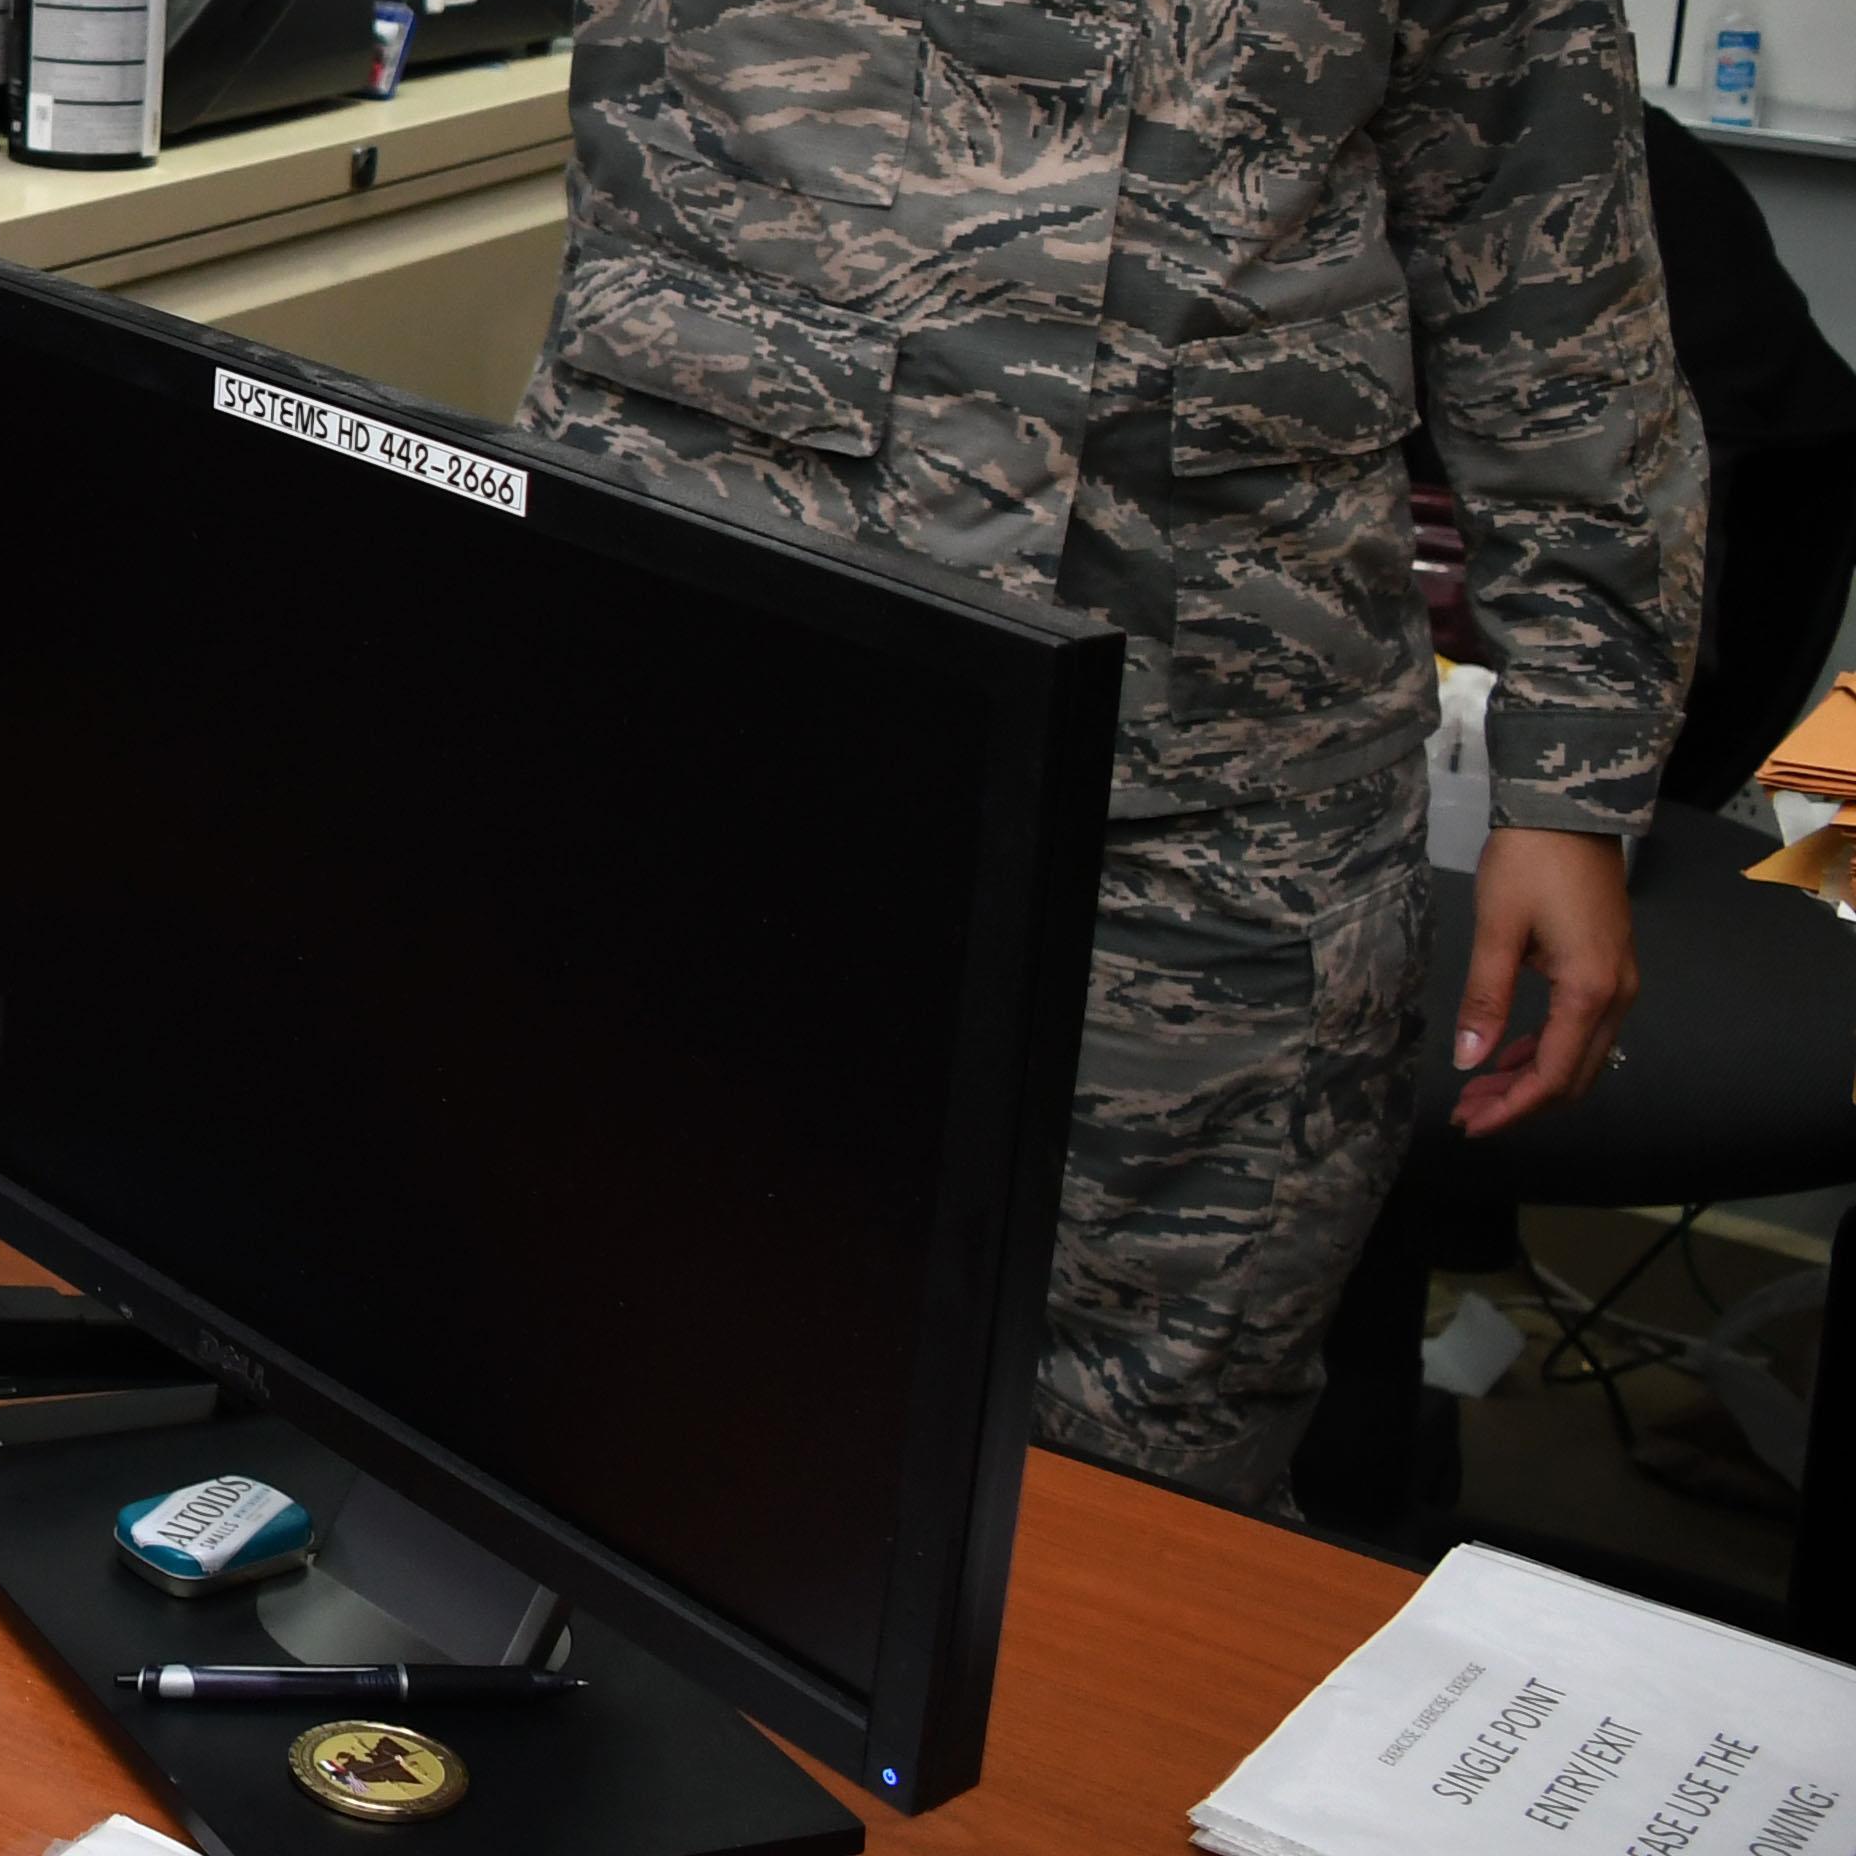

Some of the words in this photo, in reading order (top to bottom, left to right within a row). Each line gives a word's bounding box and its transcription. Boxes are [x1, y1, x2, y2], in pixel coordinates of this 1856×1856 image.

[224, 377, 328, 440] SYSTEMS
[339, 417, 370, 453] HD
[379, 433, 515, 505] 442-2666
[157, 1476, 253, 1548] ALTOIDS
[200, 1522, 239, 1551] SMALLS
[1432, 1733, 1519, 1805] SINGLE
[1490, 1676, 1567, 1742] POINT
[1525, 1716, 1643, 1831] ENTRY/EXIT
[1695, 1732, 1760, 1777] THE
[1665, 1772, 1730, 1821] USE
